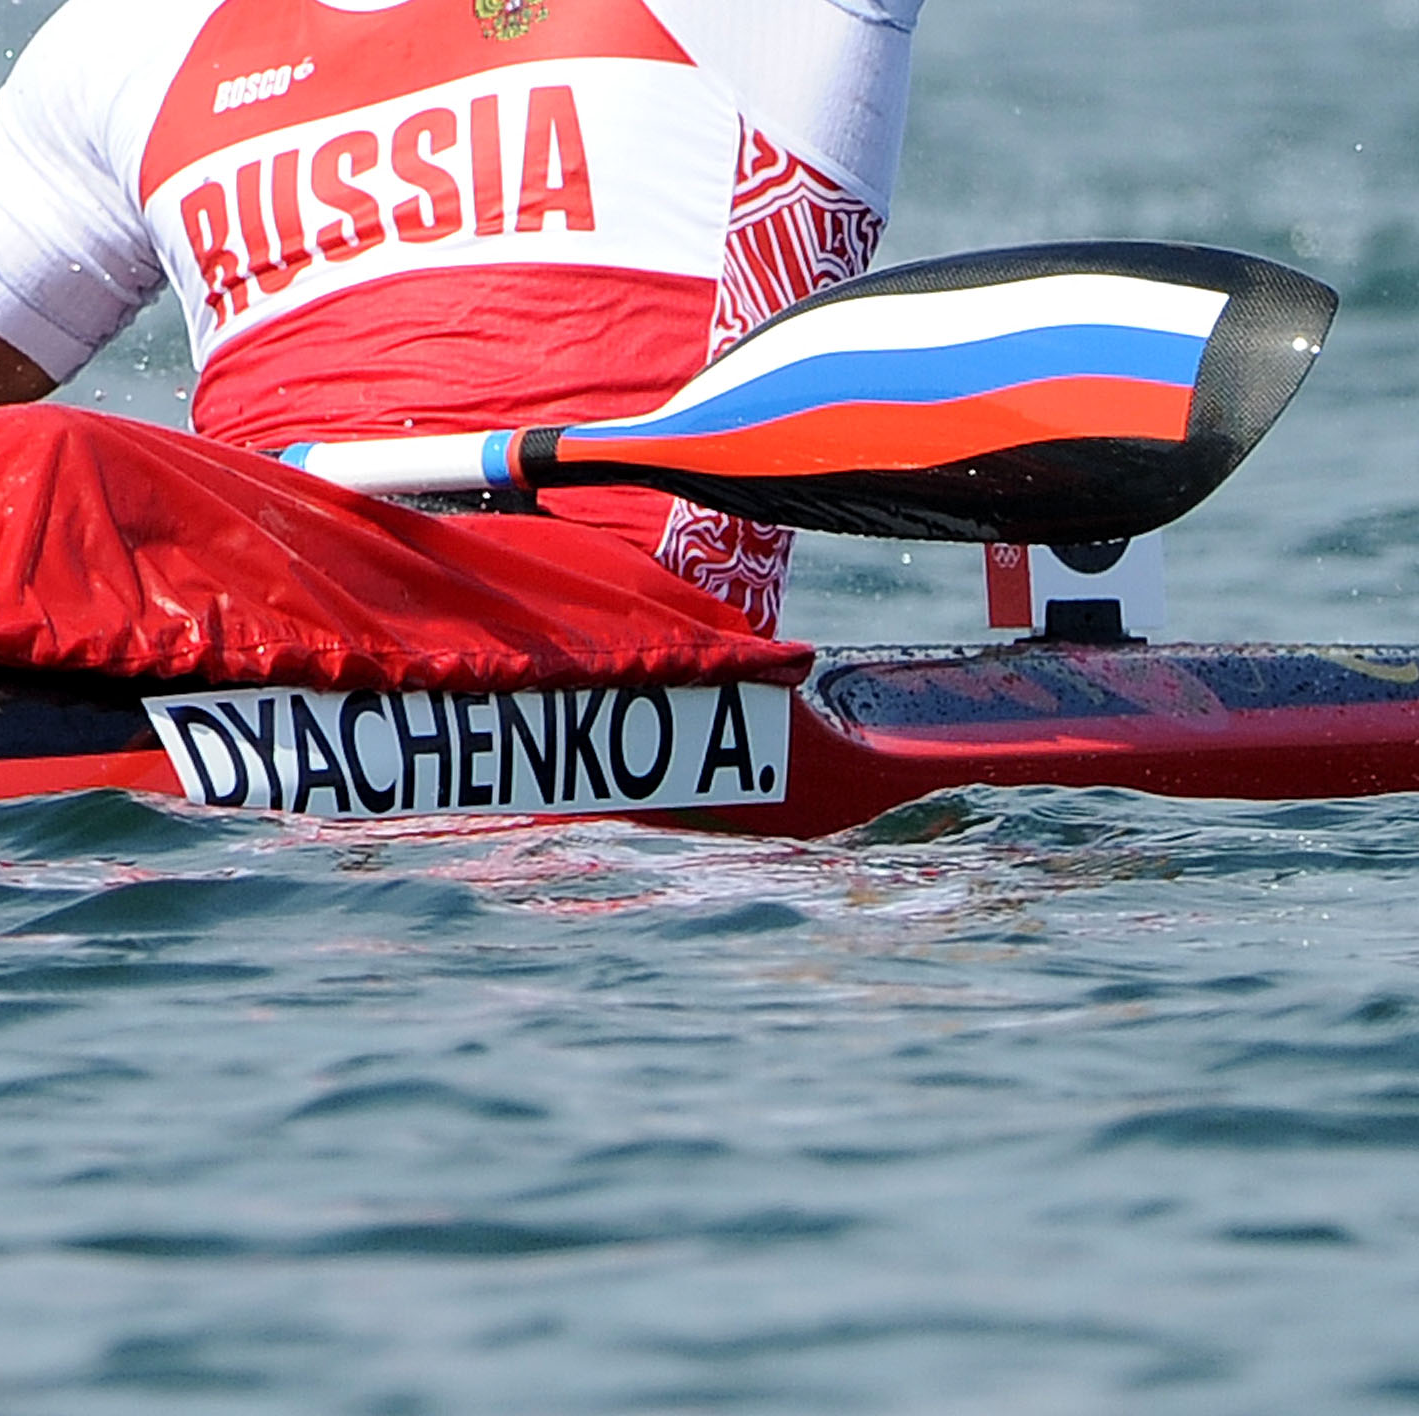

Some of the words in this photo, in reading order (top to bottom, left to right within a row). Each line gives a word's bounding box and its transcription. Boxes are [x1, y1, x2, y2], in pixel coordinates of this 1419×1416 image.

[213, 65, 292, 114] BOSCO
[181, 85, 595, 331] RUSSIA
[166, 687, 673, 814] DYACHENKO
[695, 683, 776, 794] A.
